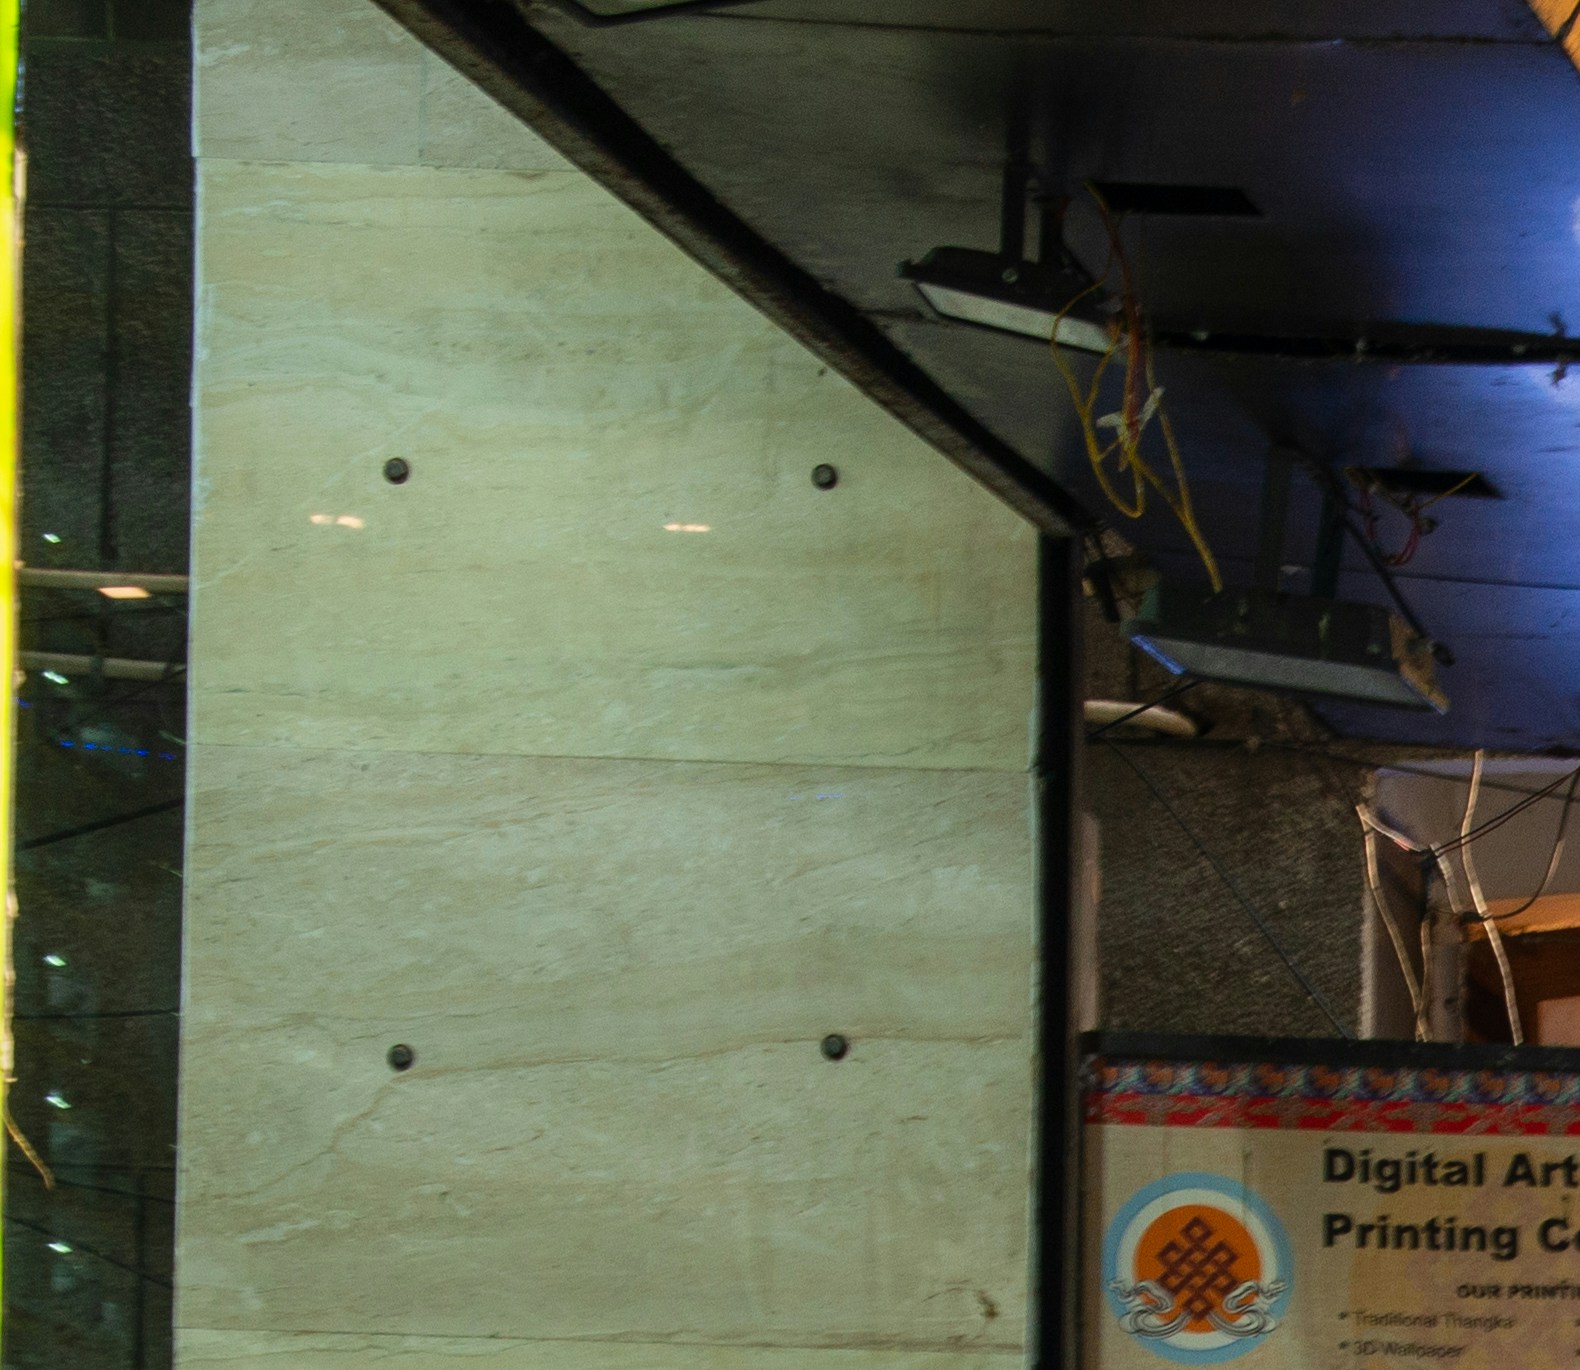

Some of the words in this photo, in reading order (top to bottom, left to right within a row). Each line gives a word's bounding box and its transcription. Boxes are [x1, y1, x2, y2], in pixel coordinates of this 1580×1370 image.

[1322, 1147, 1486, 1194] Digital
[1502, 1151, 1580, 1189] Art
[1322, 1212, 1519, 1261] Printing
[1456, 1284, 1500, 1299] OUR
[1353, 1310, 1437, 1328] Traditional
